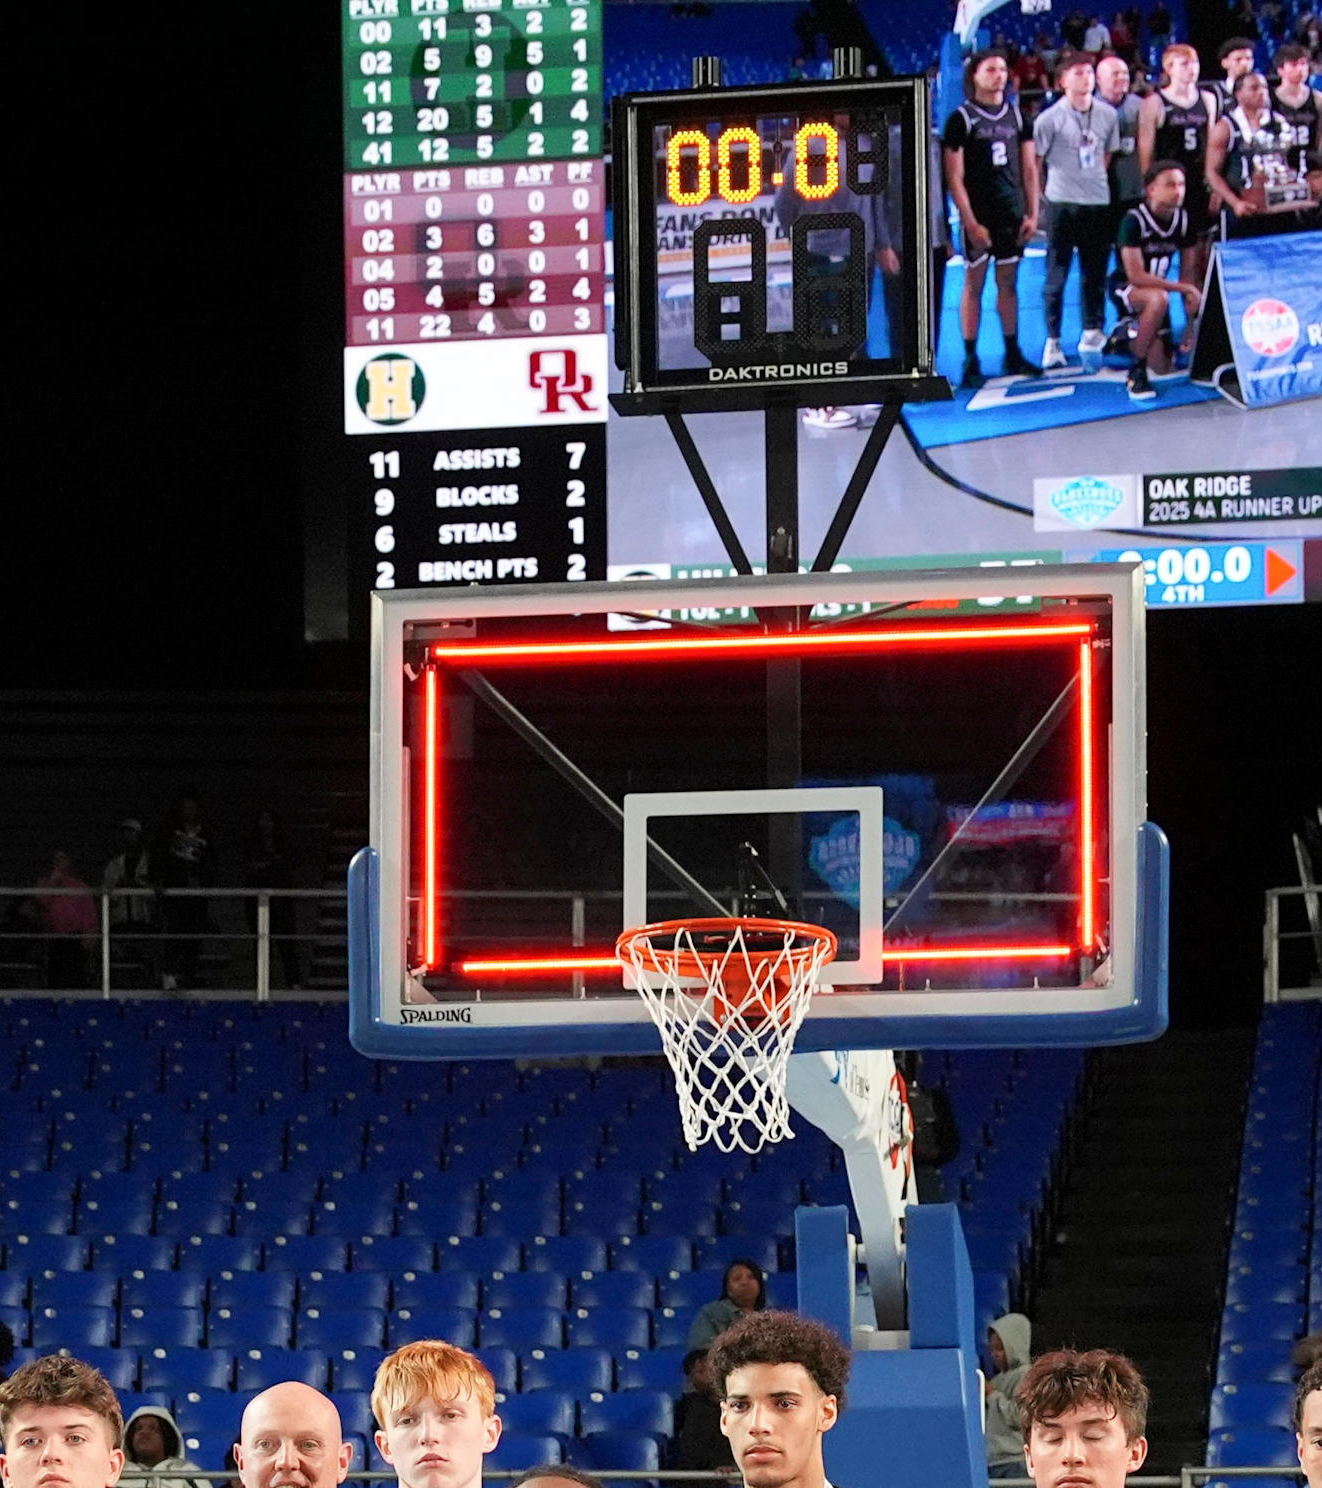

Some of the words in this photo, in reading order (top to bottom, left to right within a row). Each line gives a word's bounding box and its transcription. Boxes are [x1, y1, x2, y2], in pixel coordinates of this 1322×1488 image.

[360, 21, 391, 43] 00
[419, 17, 446, 40] 11
[476, 15, 491, 36] 3
[527, 11, 542, 33] 2
[571, 8, 587, 30] 2
[361, 51, 391, 74] 02
[425, 48, 440, 70] 5
[475, 45, 492, 67] 9
[527, 42, 543, 64] 5
[574, 39, 586, 61] 1
[364, 81, 391, 103] 11
[424, 78, 440, 100] 7
[476, 75, 492, 97] 2
[527, 71, 543, 94] 0
[572, 69, 587, 91] 2
[363, 111, 392, 134] 12
[417, 108, 448, 131] 20
[477, 105, 492, 127] 5
[530, 102, 542, 124] 1
[571, 99, 588, 121] 4
[363, 141, 391, 164] 41
[419, 138, 448, 161] 12
[477, 136, 493, 158] 5
[528, 133, 544, 155] 2
[573, 130, 588, 152] 2
[352, 175, 401, 193] PLYR
[413, 171, 450, 190] PTS
[465, 168, 504, 187] REB
[515, 165, 554, 183] AST
[568, 163, 593, 180] PF
[364, 199, 392, 221] 01
[426, 197, 442, 218] 0
[477, 194, 493, 215] 0
[528, 191, 544, 212] 0
[573, 188, 589, 210] 0
[363, 229, 394, 252] 02
[427, 227, 442, 249] 3
[478, 224, 494, 246] 6
[529, 221, 545, 243] 3
[576, 218, 588, 240] 1
[363, 259, 394, 281] 04
[427, 256, 443, 278] 2
[478, 253, 494, 275] 0
[529, 251, 545, 273] 0
[576, 248, 588, 269] 1
[364, 288, 394, 311] 05
[426, 285, 443, 307] 4
[479, 283, 495, 305] 5
[530, 280, 545, 302] 2
[573, 278, 590, 299] 4
[366, 318, 393, 340] 11
[420, 315, 451, 338] 22
[478, 312, 495, 334] 4
[530, 310, 546, 332] 0
[575, 308, 590, 329] 3
[710, 362, 852, 384] DAKTRONICS
[370, 451, 399, 478] 11
[434, 448, 520, 470] ASSISTS
[566, 443, 585, 469] 7
[375, 489, 394, 515] 9
[436, 485, 519, 507] BLOCKS
[566, 480, 585, 506] 2
[1149, 478, 1189, 501] OAK
[1194, 474, 1251, 498] RIDGE
[1149, 501, 1190, 521] 2025
[1194, 500, 1216, 519] 4A
[1221, 497, 1292, 518] RUNNER
[1298, 495, 1322, 515] UP
[375, 526, 394, 552] 6
[439, 522, 516, 544] STEALS
[569, 517, 583, 544] 1
[376, 562, 394, 588] 2
[418, 559, 493, 582] BENCH
[497, 557, 538, 579] PTS
[567, 554, 586, 580] 2
[1161, 585, 1205, 603] 4TH
[400, 1007, 471, 1024] SPALDING
